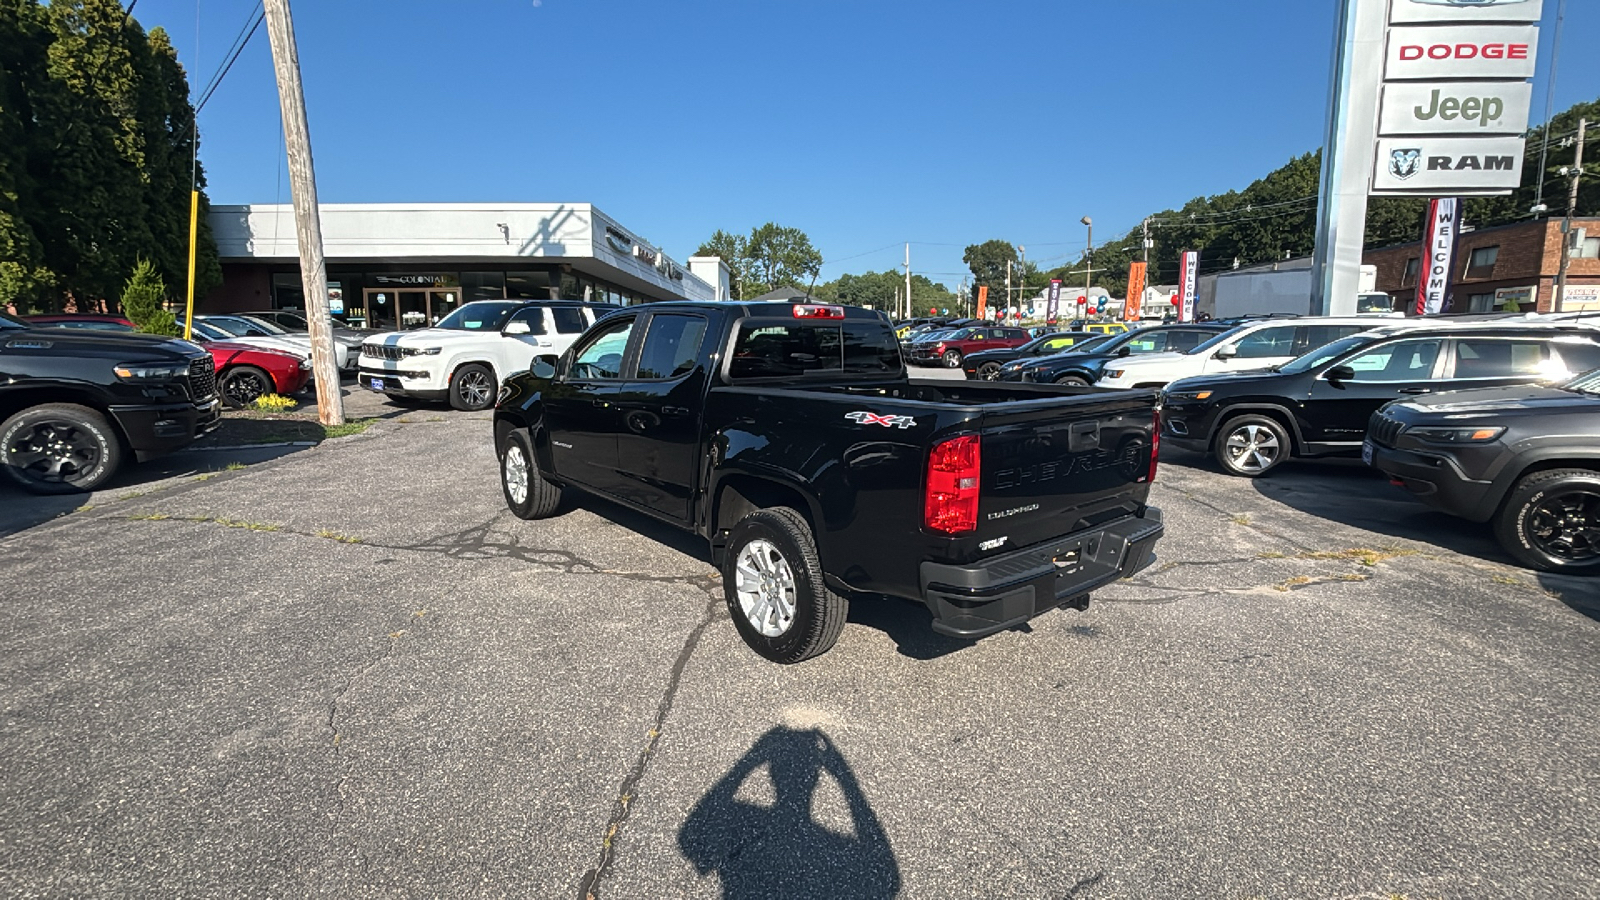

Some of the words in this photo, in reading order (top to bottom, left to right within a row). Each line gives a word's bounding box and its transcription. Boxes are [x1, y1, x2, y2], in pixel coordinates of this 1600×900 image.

[1399, 43, 1529, 60] DODGE
[1414, 89, 1503, 127] Jeep
[1427, 155, 1515, 171] RAM
[1429, 212, 1453, 301] WELCOME
[1184, 261, 1196, 313] WELCOME
[987, 503, 1040, 520] COLORADO
